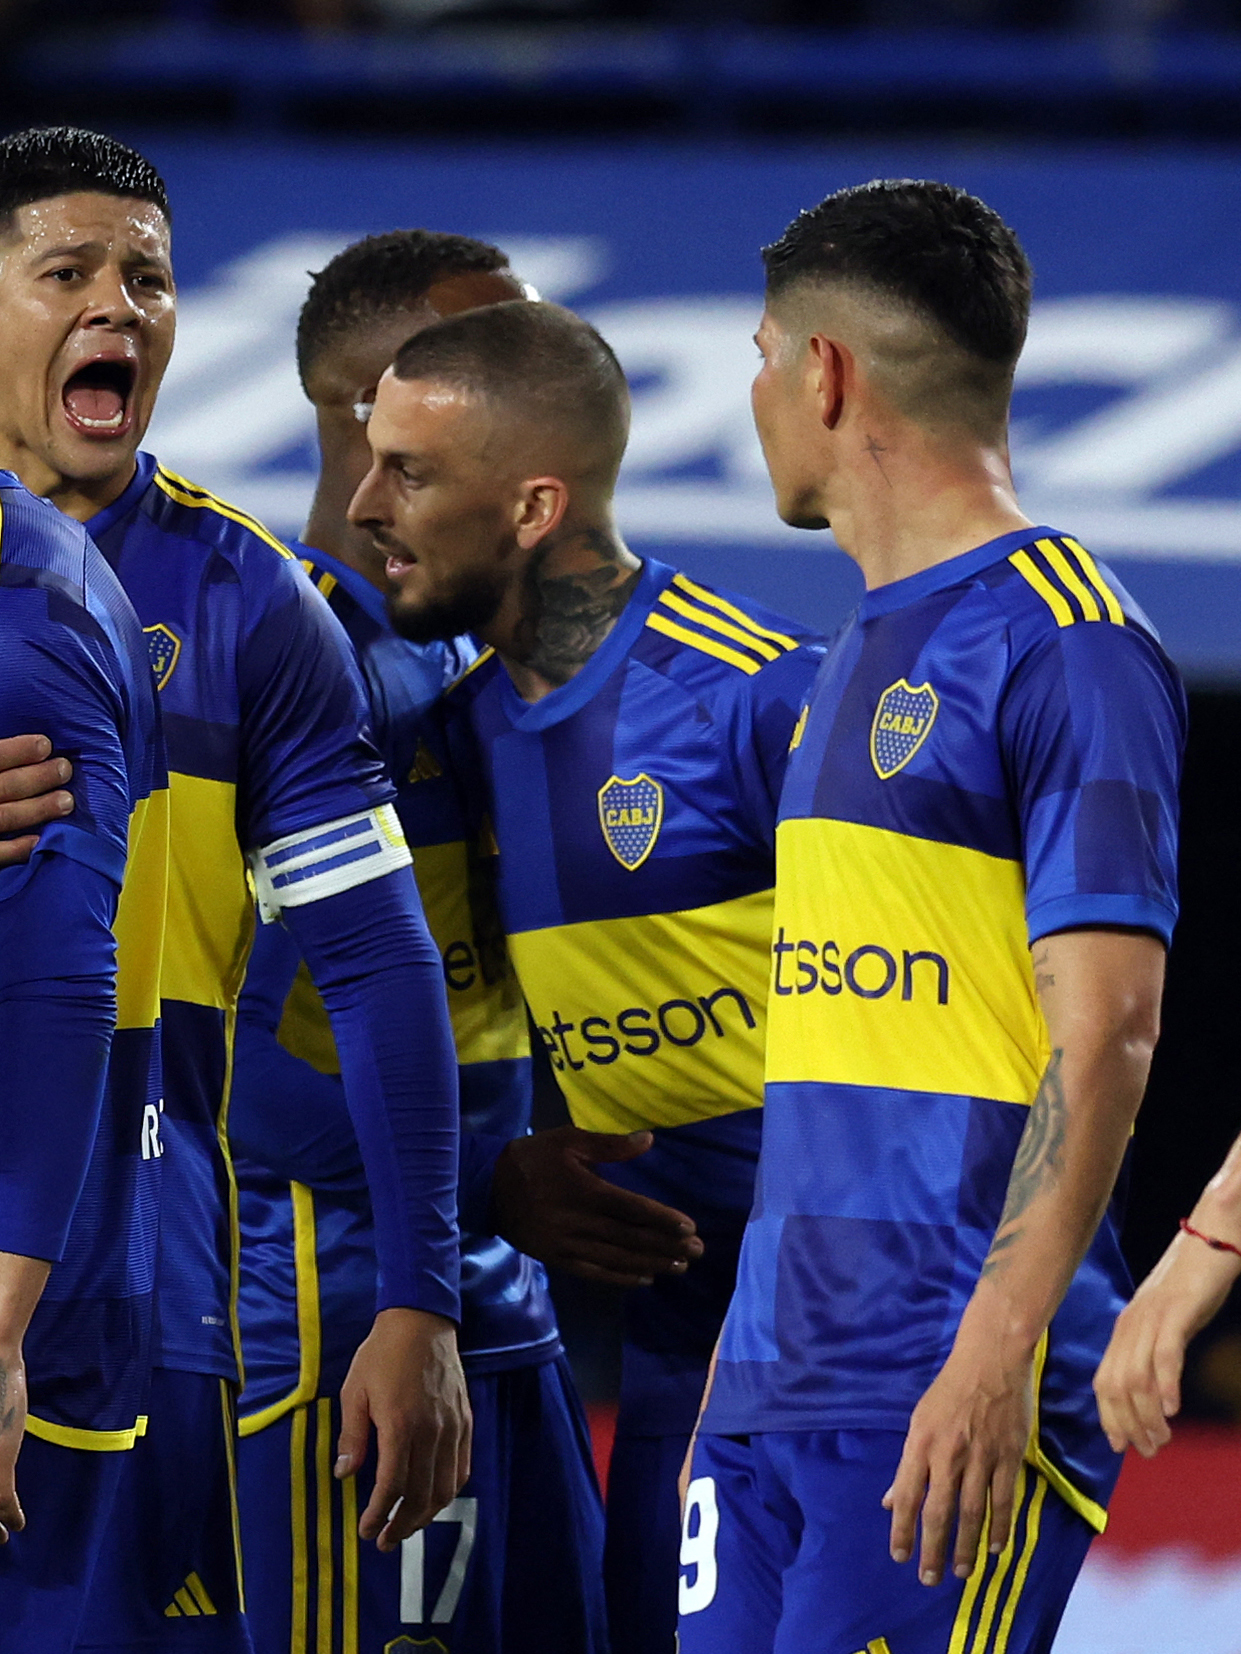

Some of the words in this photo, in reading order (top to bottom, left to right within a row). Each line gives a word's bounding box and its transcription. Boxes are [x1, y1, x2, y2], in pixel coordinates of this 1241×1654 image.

[879, 712, 926, 736] CABJ
[606, 807, 655, 827] CABJ
[773, 927, 949, 1005] tsson
[141, 1098, 164, 1160] R
[388, 1495, 478, 1624] 17
[679, 1476, 720, 1616] 9
